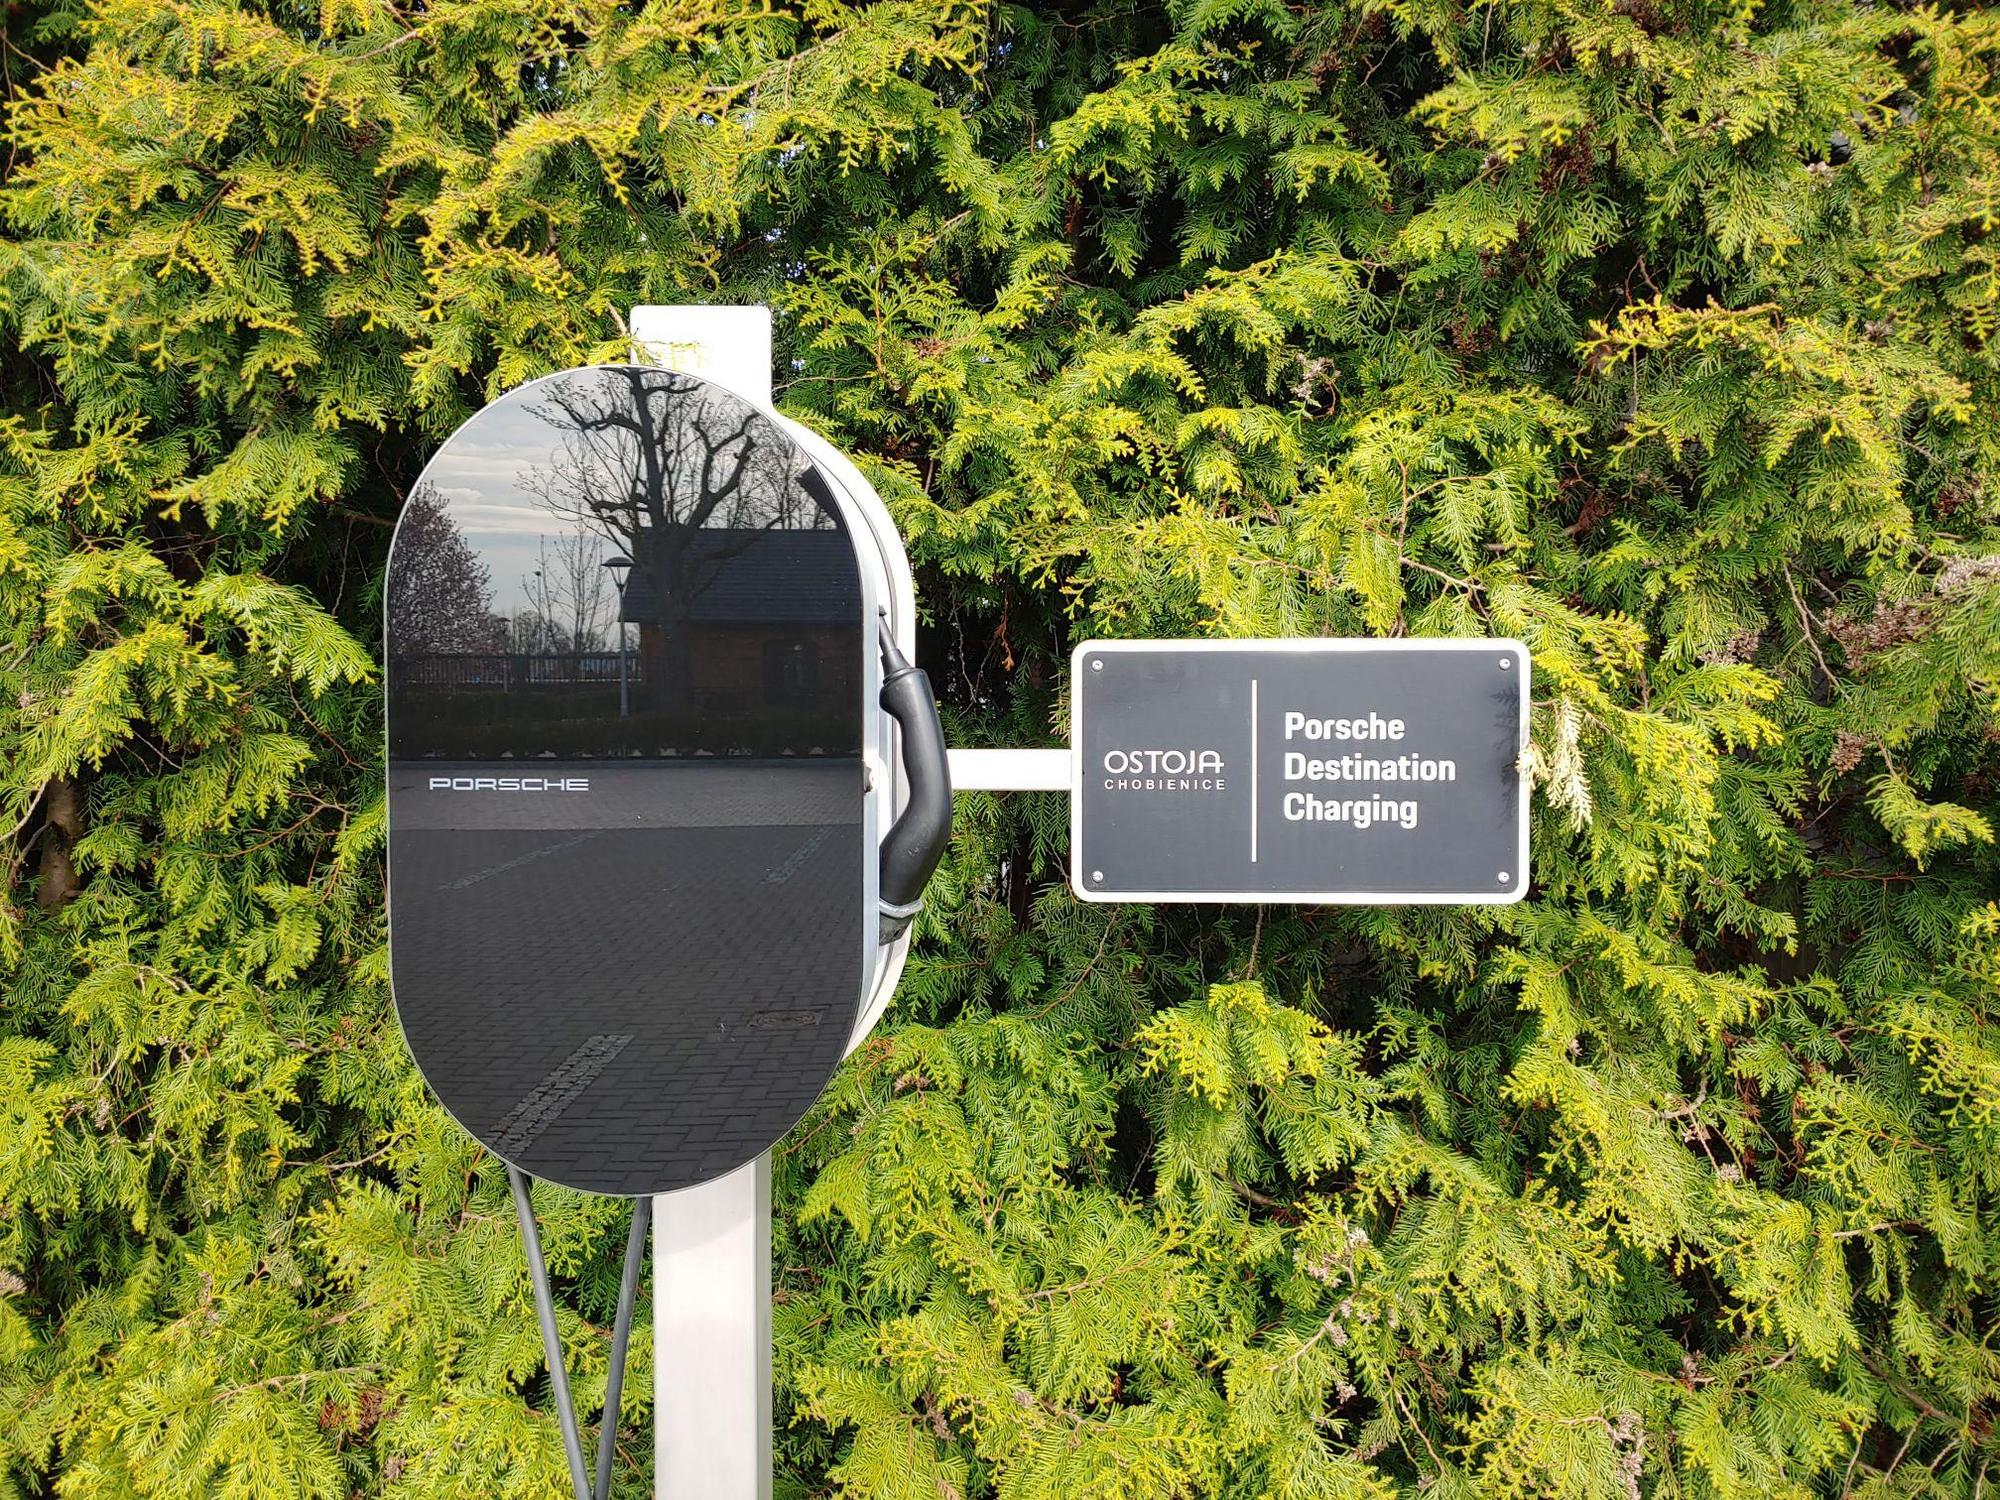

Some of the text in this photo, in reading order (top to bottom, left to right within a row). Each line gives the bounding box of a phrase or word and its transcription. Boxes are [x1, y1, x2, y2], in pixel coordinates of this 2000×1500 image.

[1284, 711, 1406, 741] Porsche
[1103, 749, 1225, 775] OSTOJA
[1284, 752, 1456, 782] Destination
[428, 777, 590, 792] PORSCHE
[1103, 779, 1225, 791] CHOBIENICE
[1283, 792, 1418, 830] Charging
